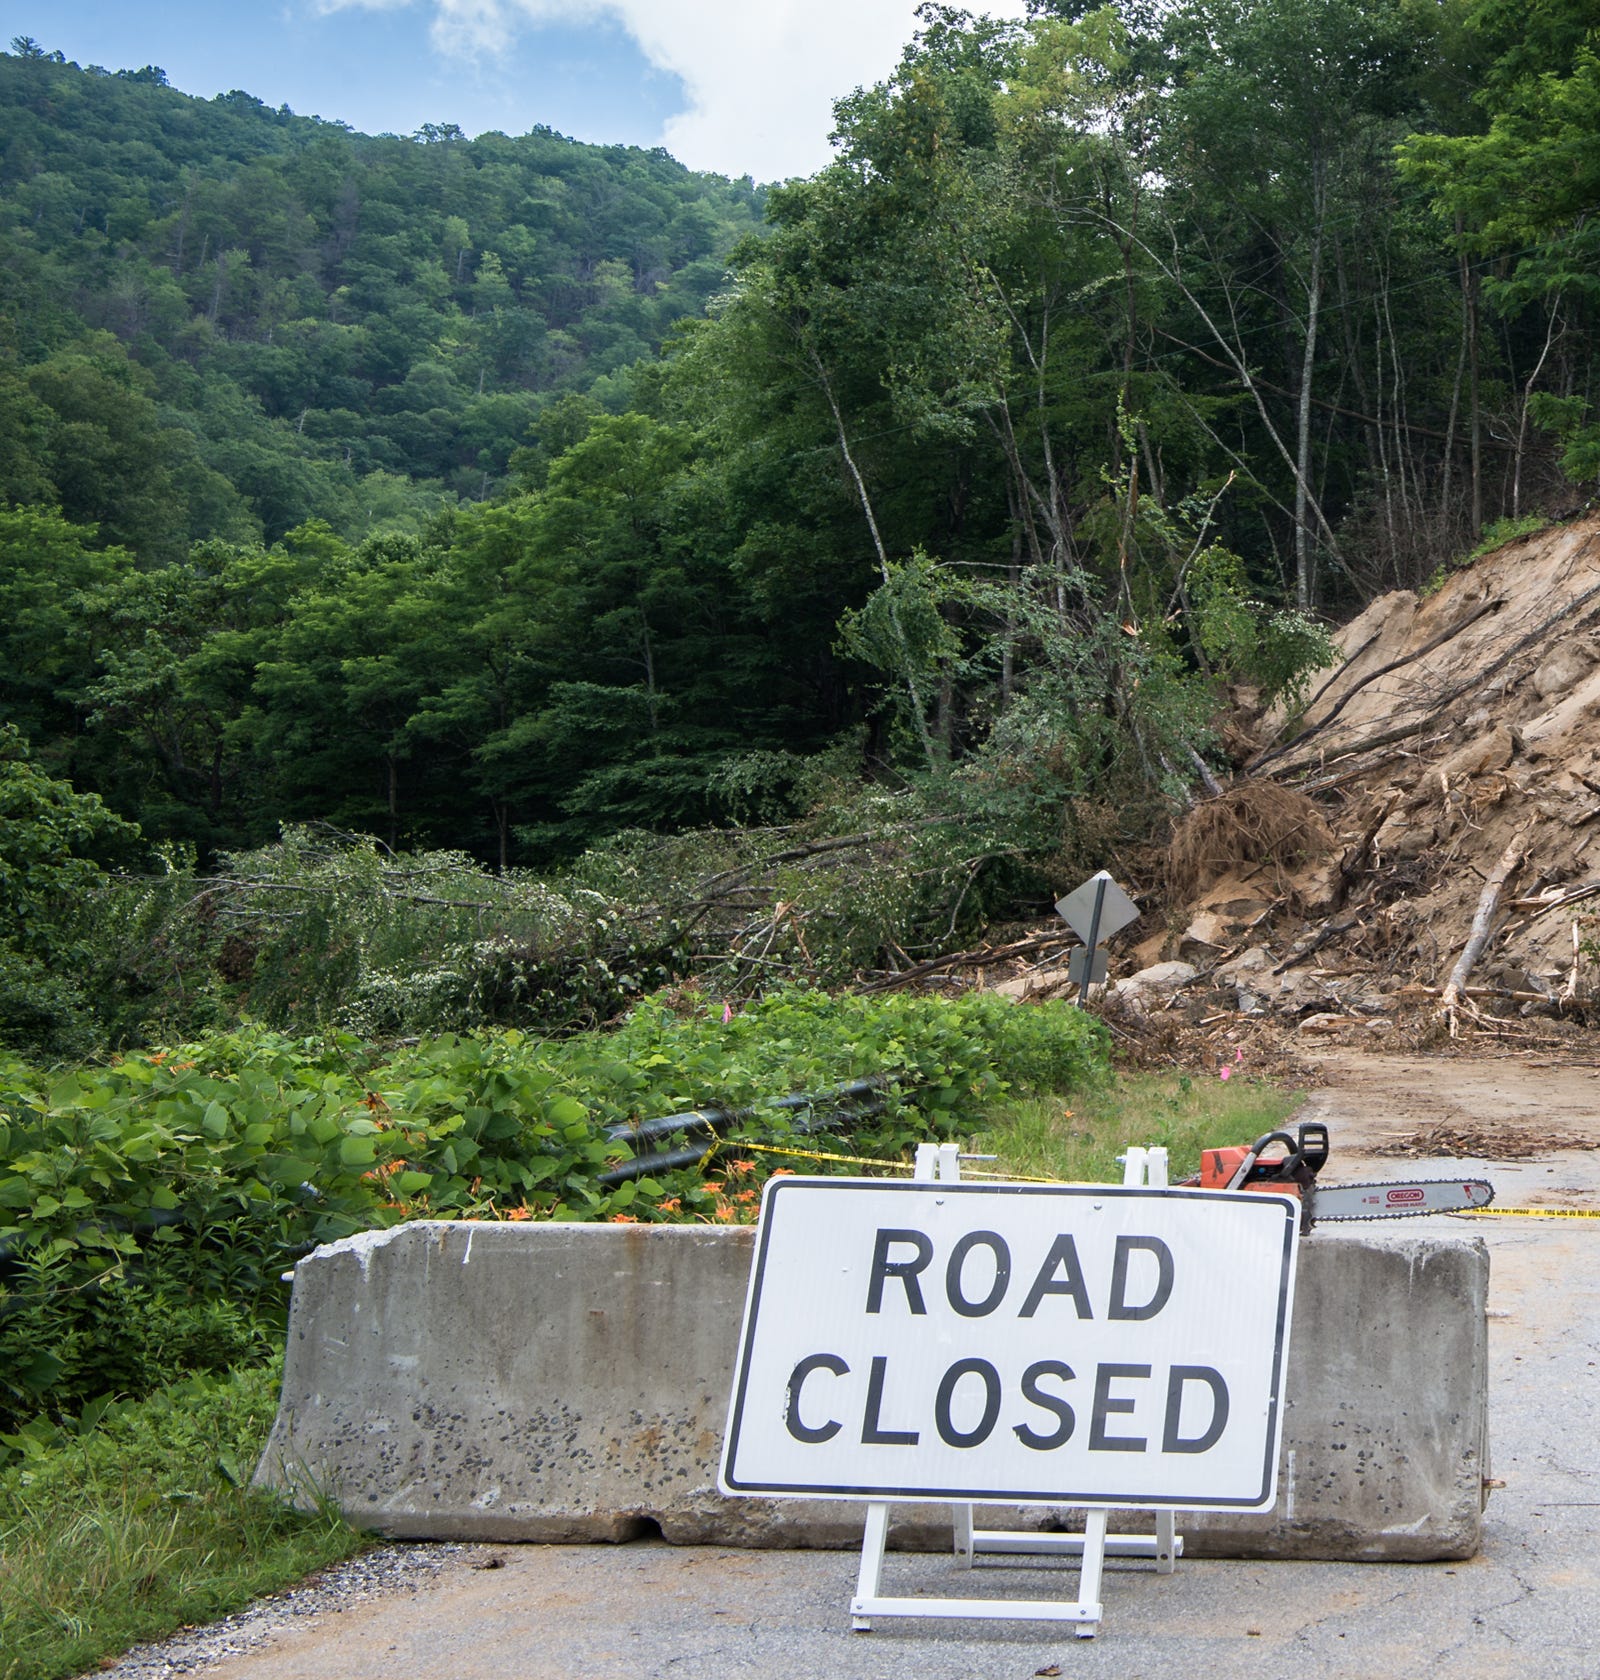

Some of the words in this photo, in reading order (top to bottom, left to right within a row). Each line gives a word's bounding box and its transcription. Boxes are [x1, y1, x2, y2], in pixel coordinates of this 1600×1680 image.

[1390, 1191, 1420, 1200] OREGON
[865, 1228, 1175, 1321] ROAD
[783, 1353, 1230, 1454] CLOSED
